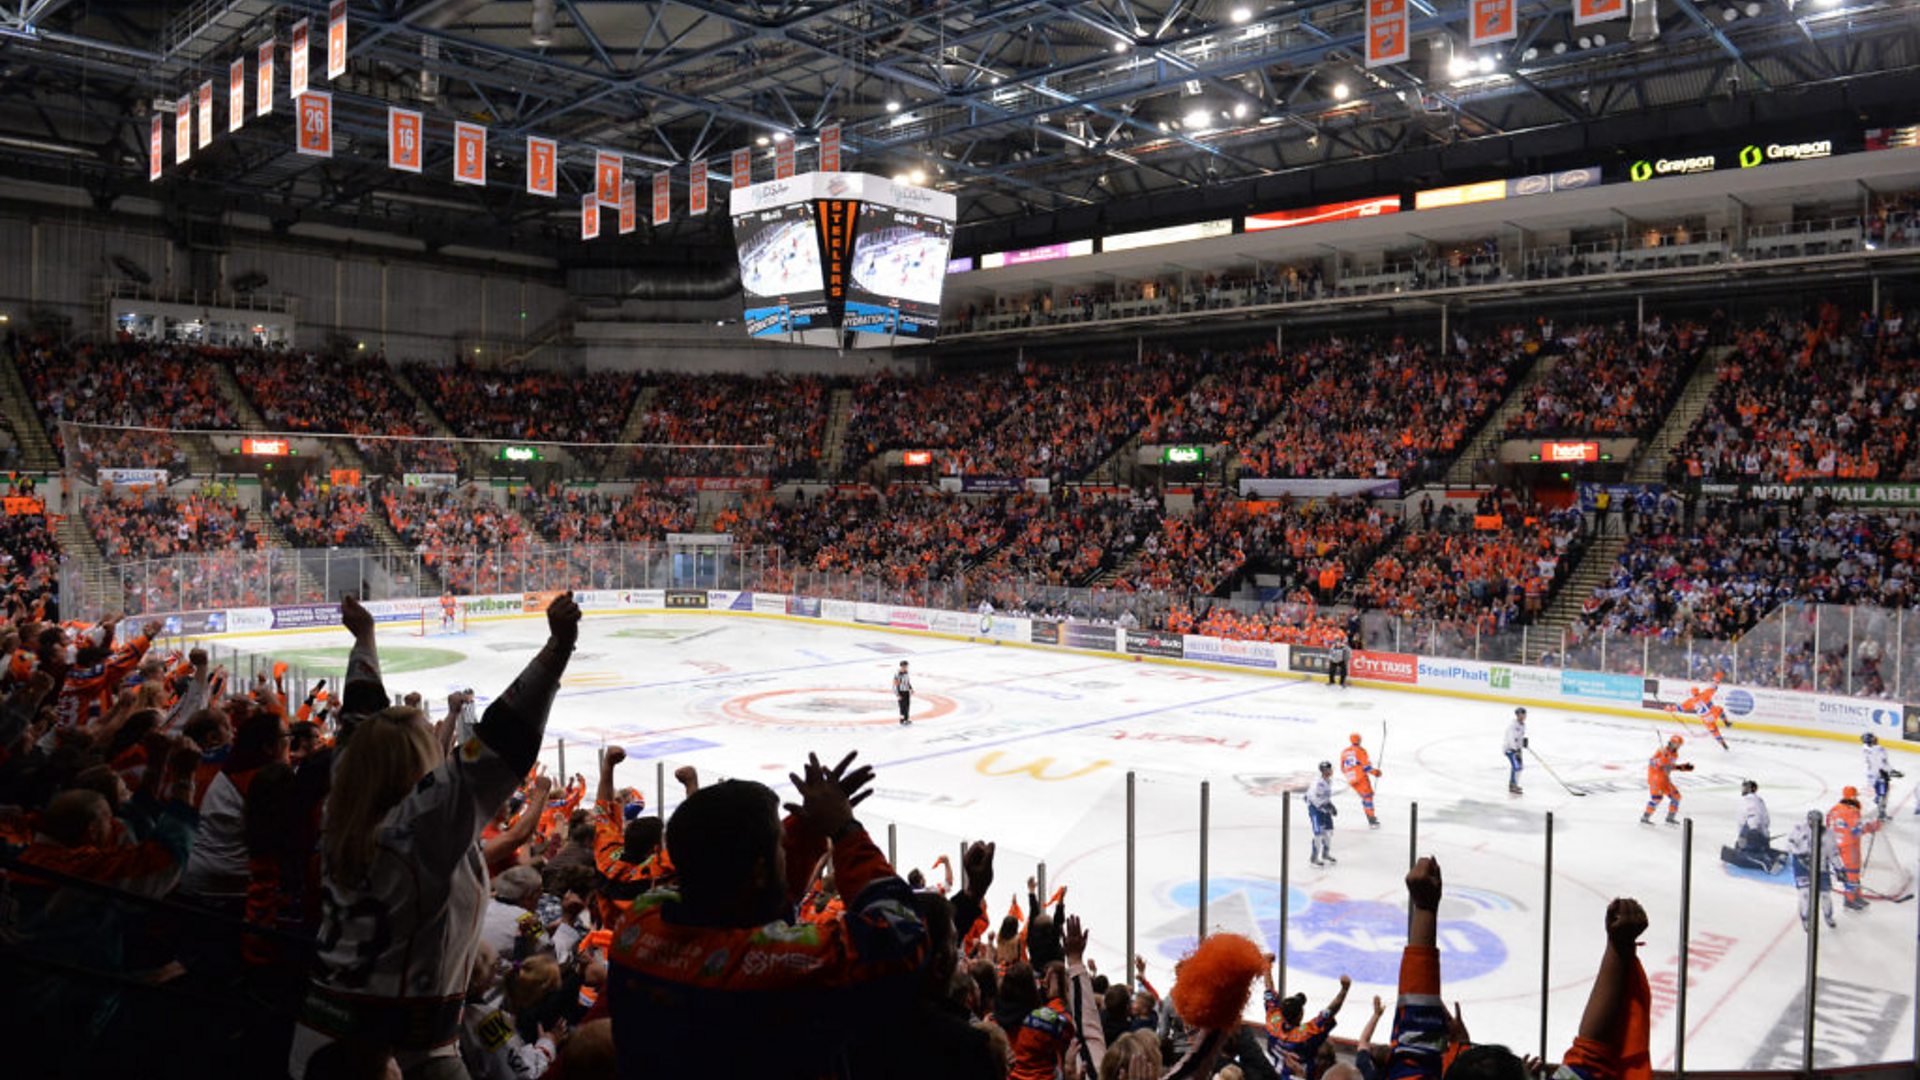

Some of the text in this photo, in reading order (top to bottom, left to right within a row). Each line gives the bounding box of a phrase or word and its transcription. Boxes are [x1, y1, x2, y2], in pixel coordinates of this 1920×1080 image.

[305, 109, 324, 134] 26
[398, 127, 414, 150] 16
[1766, 140, 1832, 159] Grayson
[1655, 155, 1715, 175] Grayson
[830, 200, 843, 298] STEELERS
[1752, 486, 1804, 501] NOW
[1811, 485, 1920, 503] AVAILABL
[1353, 655, 1379, 671] CITY
[1382, 660, 1413, 674] TAXIS
[1418, 664, 1489, 682] SteelPhalt
[1819, 702, 1870, 717] DISTINCT
